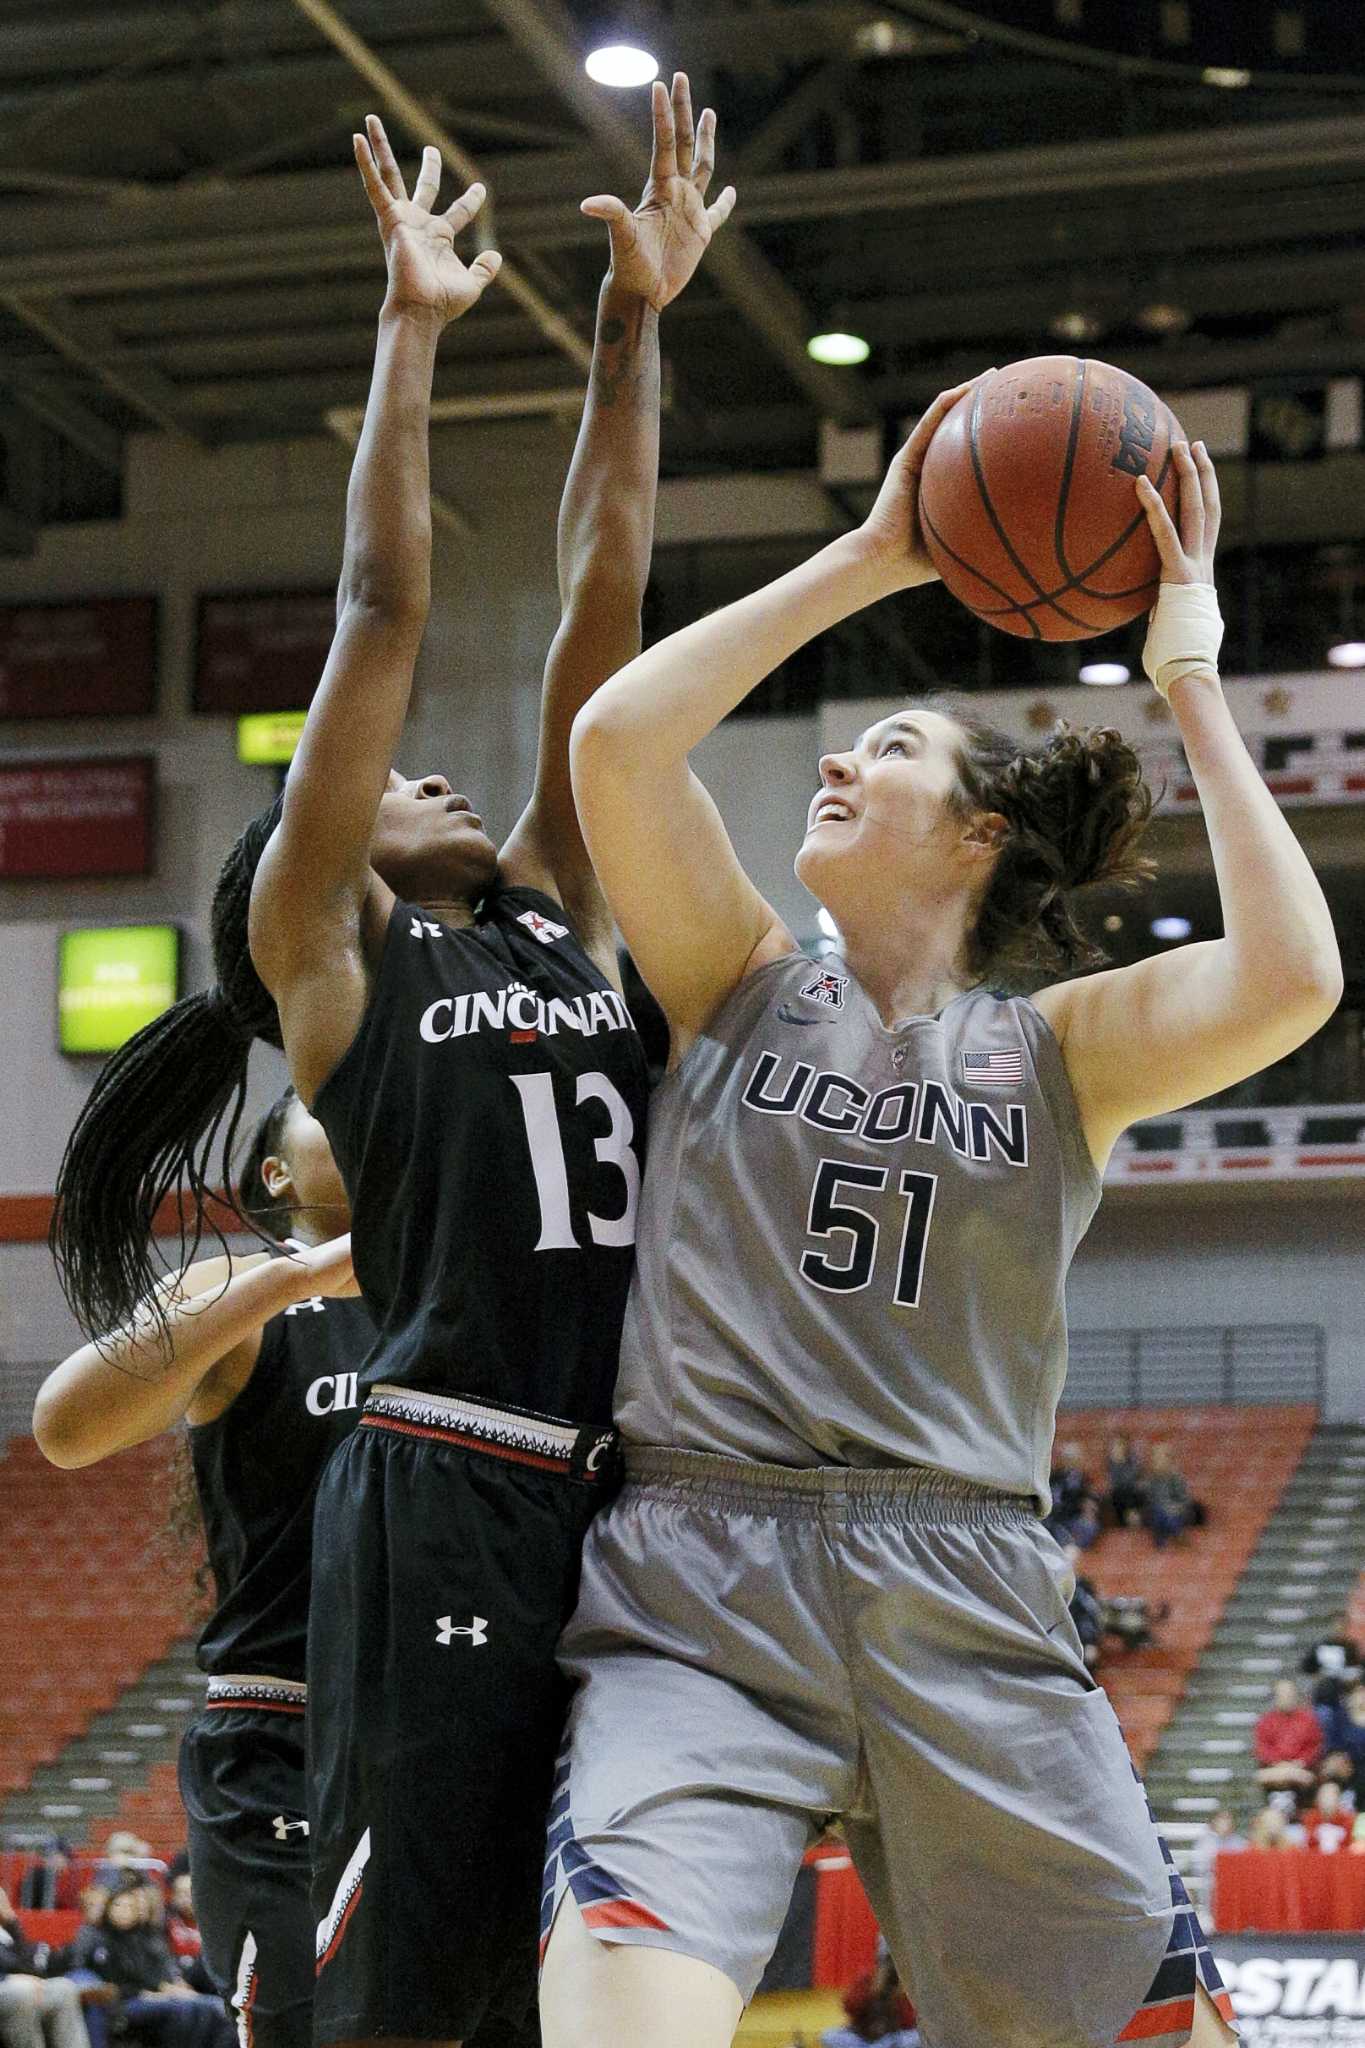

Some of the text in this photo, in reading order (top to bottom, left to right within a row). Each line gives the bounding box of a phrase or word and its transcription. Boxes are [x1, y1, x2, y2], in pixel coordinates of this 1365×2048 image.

[508, 1071, 640, 1252] 13
[741, 1050, 1029, 1168] UCONN
[799, 1157, 939, 1309] 51
[1214, 1956, 1365, 2017] STA
